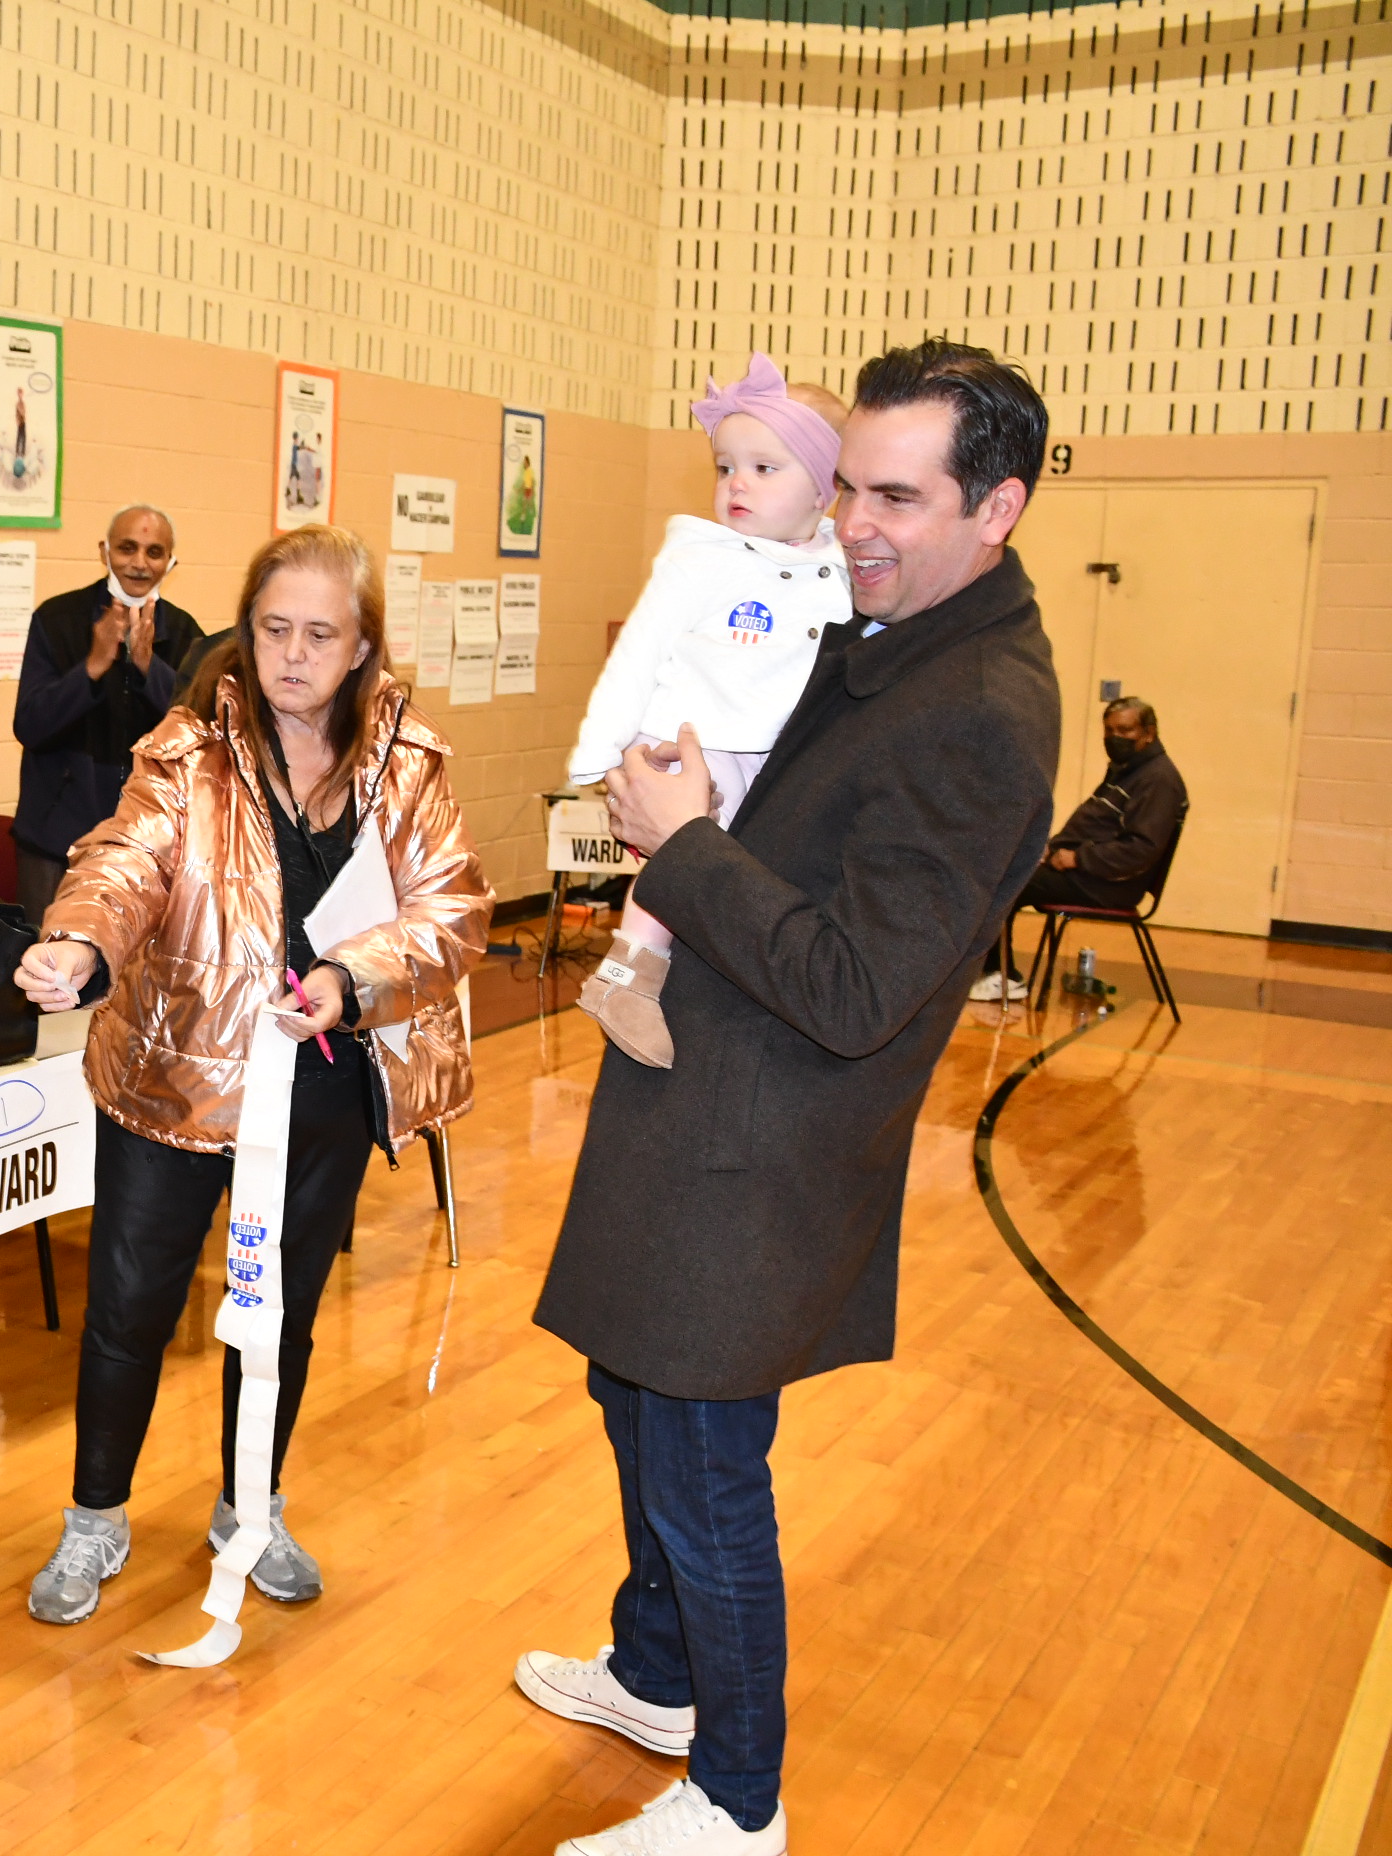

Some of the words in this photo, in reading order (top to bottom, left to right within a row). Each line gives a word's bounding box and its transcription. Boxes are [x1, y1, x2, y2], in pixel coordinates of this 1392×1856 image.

[1051, 444, 1072, 474] 9
[752, 604, 757, 616] I
[735, 614, 768, 631] VOTED
[572, 838, 624, 864] WARD
[608, 965, 626, 978] UGG
[235, 1224, 262, 1237] VOTED
[232, 1259, 258, 1273] VOTED
